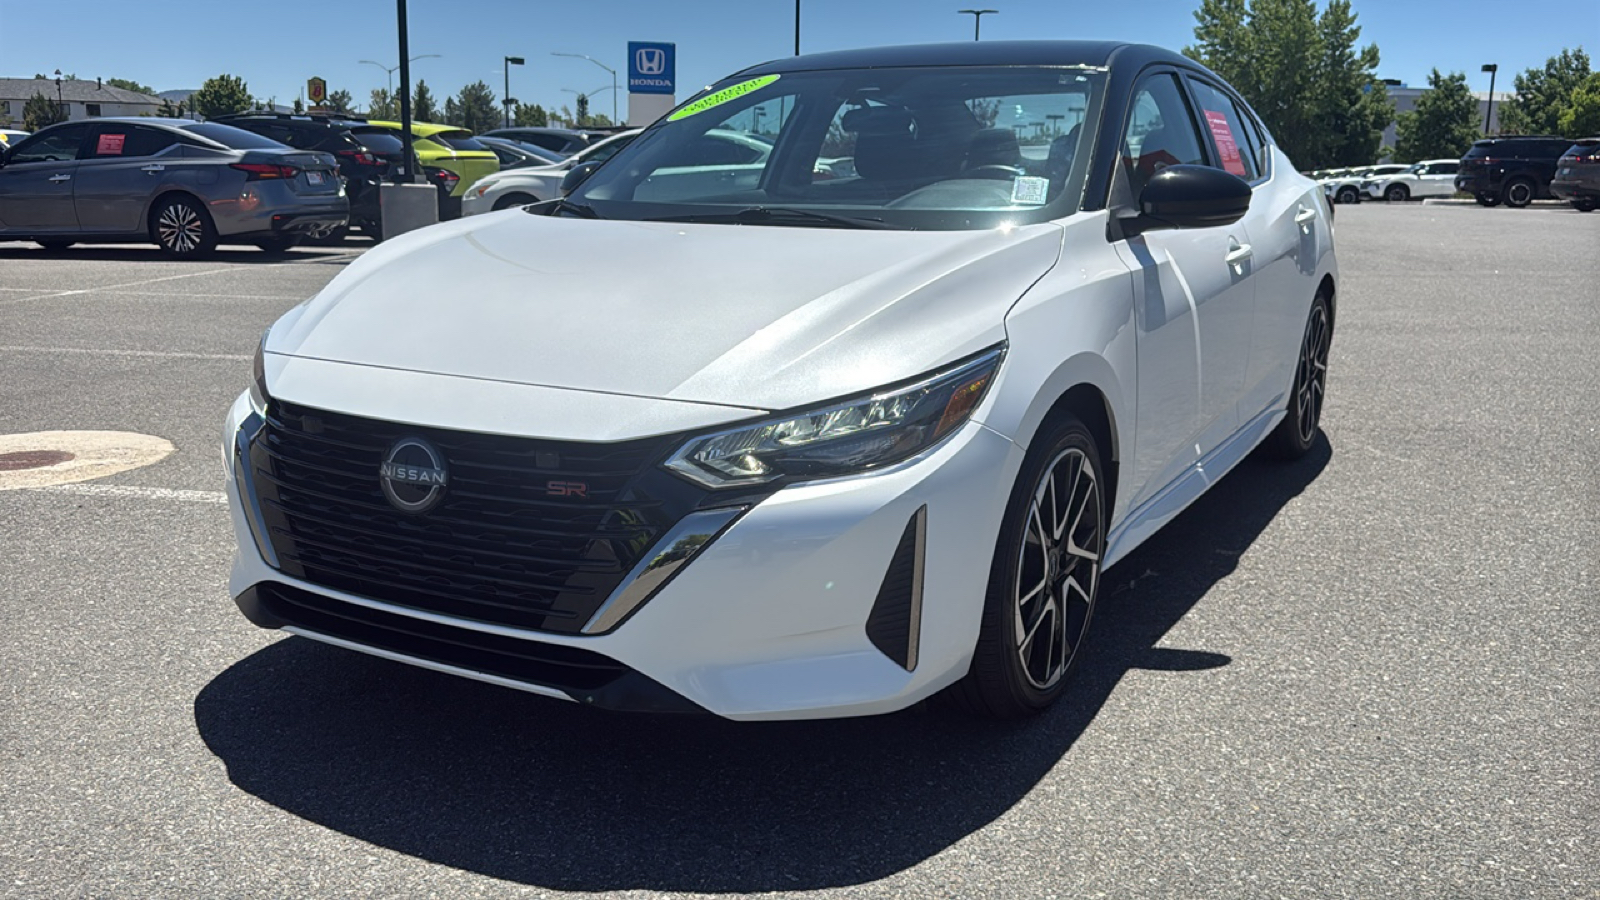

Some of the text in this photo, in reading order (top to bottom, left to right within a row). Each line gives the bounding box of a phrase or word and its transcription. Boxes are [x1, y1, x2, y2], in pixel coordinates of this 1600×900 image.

[629, 79, 672, 87] HONDA
[380, 464, 445, 484] NISSAN
[546, 480, 587, 497] SR
